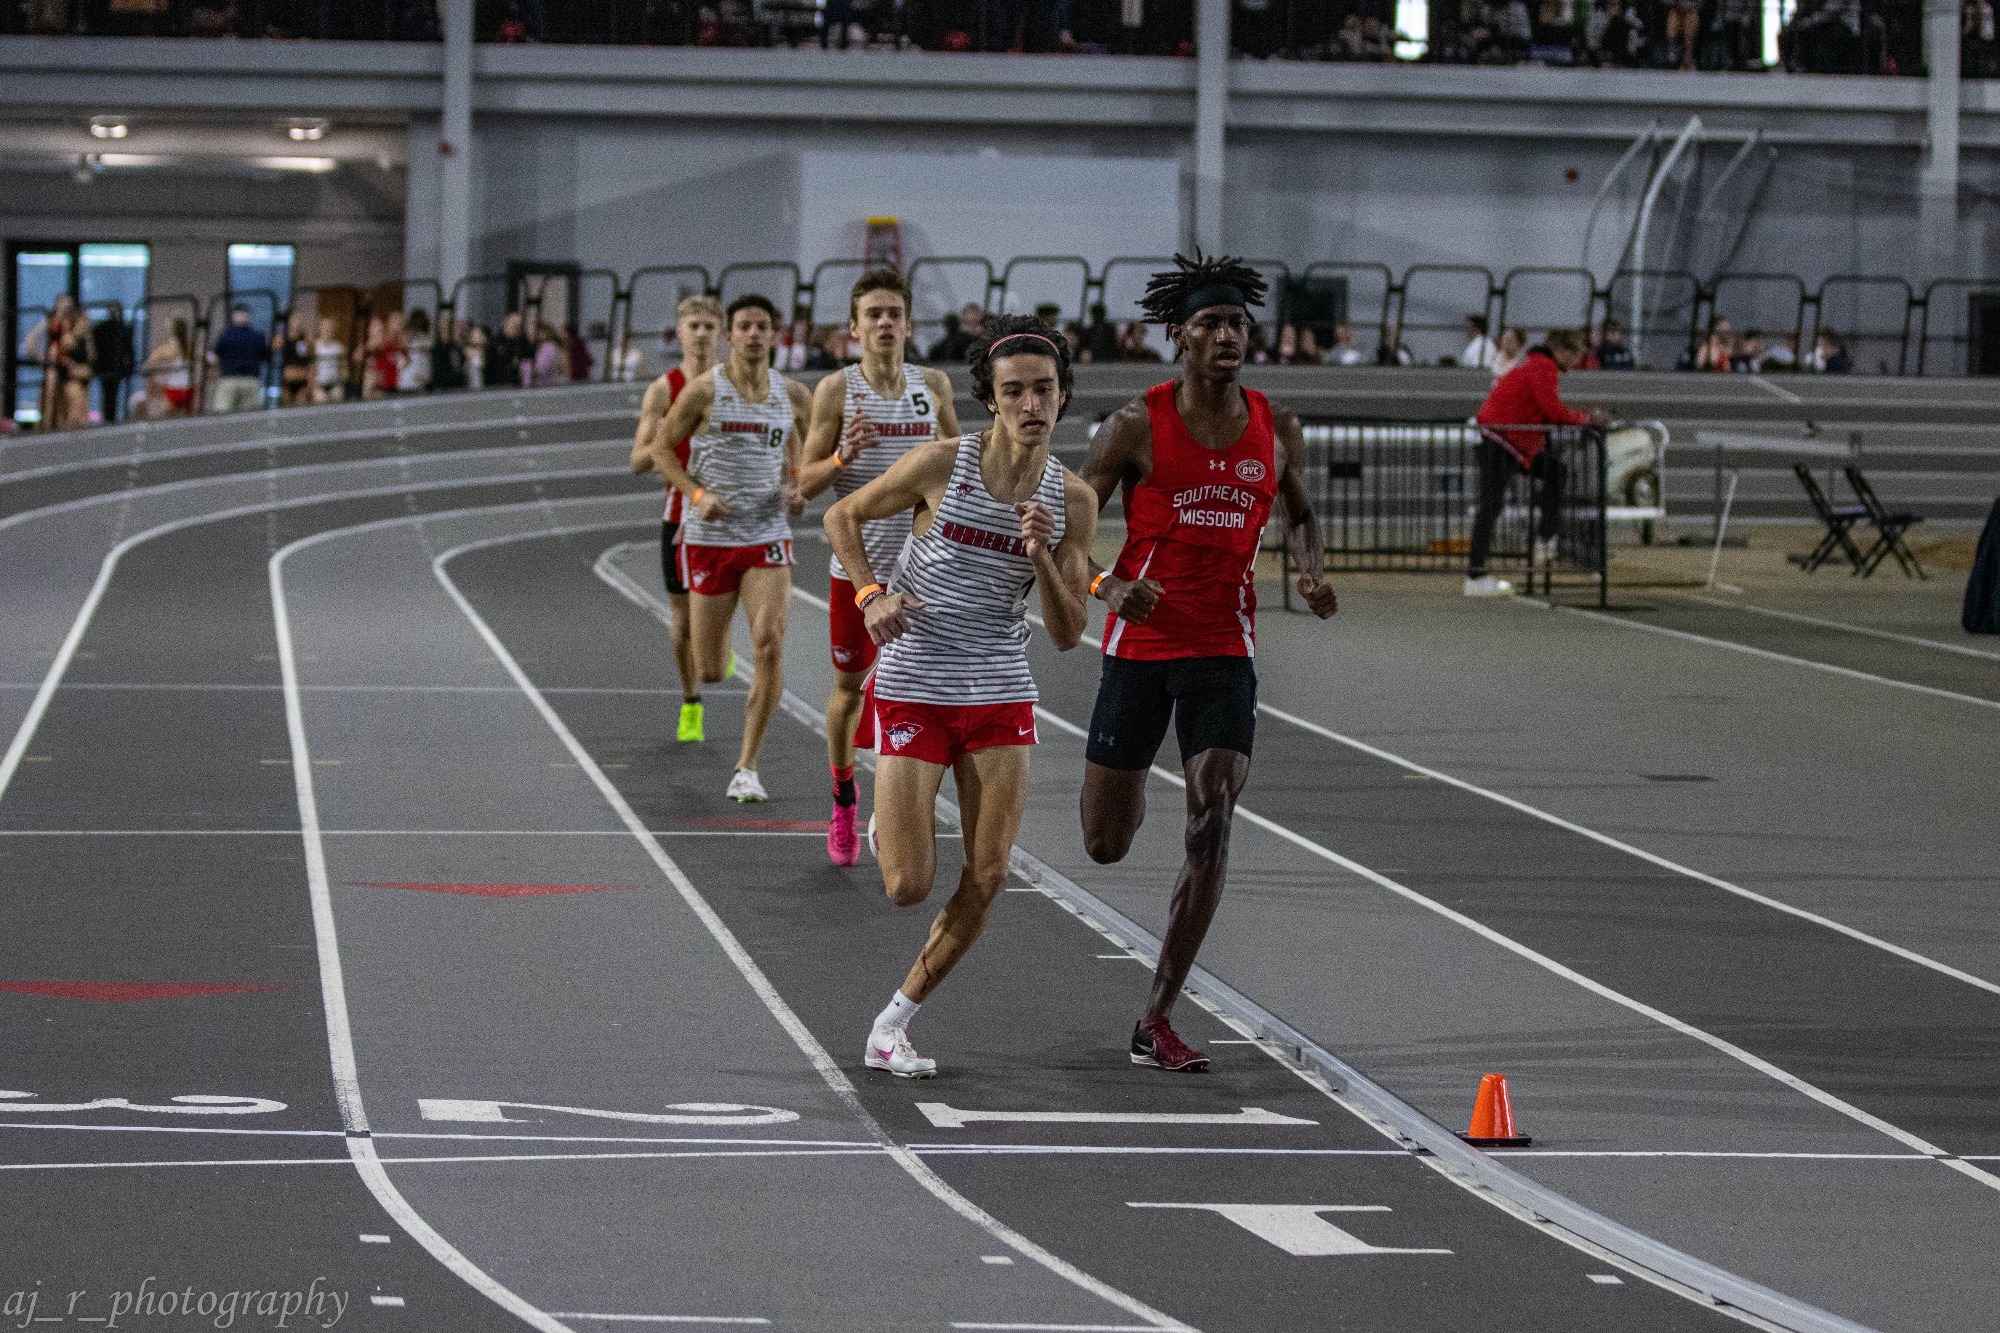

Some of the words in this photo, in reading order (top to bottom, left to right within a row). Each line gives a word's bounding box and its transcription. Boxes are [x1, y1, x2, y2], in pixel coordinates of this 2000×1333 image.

[912, 391, 930, 416] 5
[770, 428, 784, 448] 8
[1242, 466, 1260, 476] OVC
[1173, 485, 1256, 510] SOUTHEAST
[1178, 509, 1245, 528] MISSOURI
[767, 541, 784, 562] 8
[416, 1098, 801, 1126] 2
[914, 1102, 1320, 1128] 1
